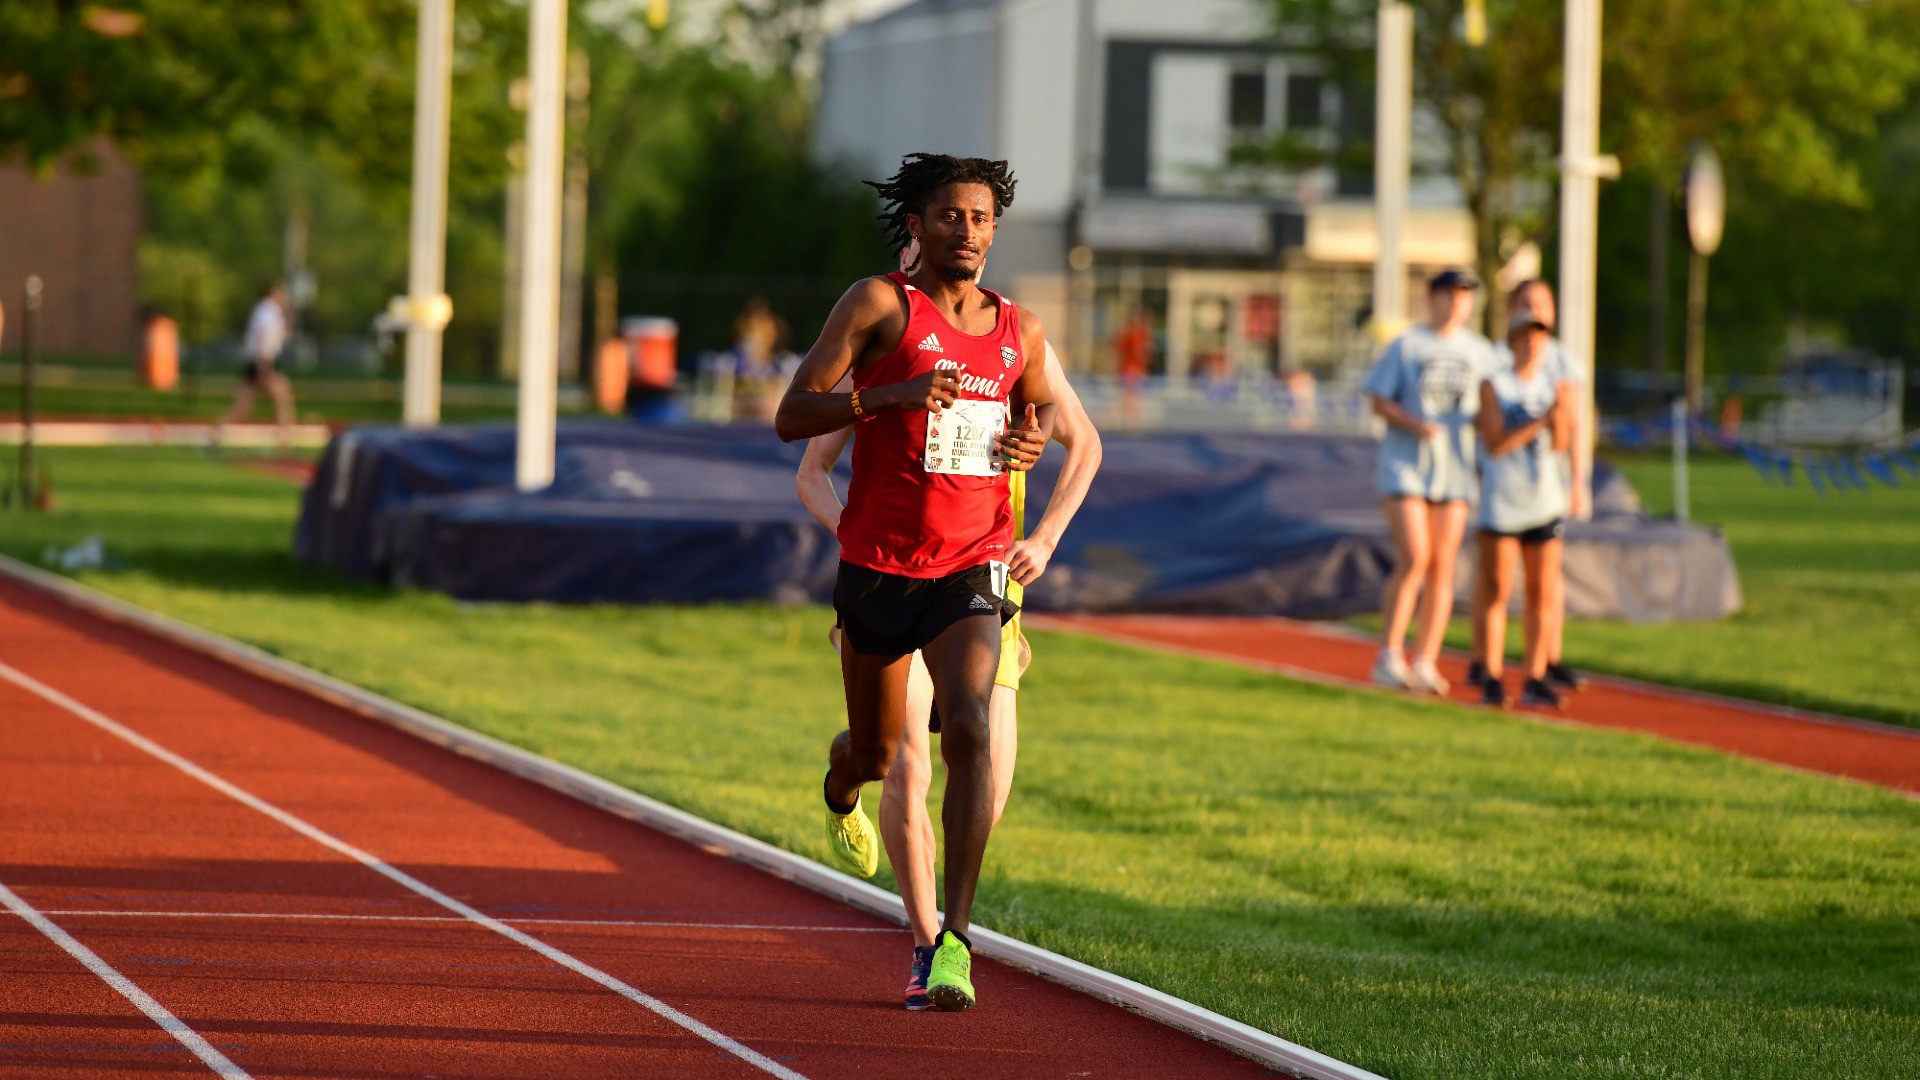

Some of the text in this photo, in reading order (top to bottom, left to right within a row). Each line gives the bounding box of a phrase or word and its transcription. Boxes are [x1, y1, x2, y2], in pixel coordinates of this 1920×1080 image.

[918, 344, 943, 353] adidas
[934, 359, 1004, 397] Mami
[955, 425, 986, 440] 1207
